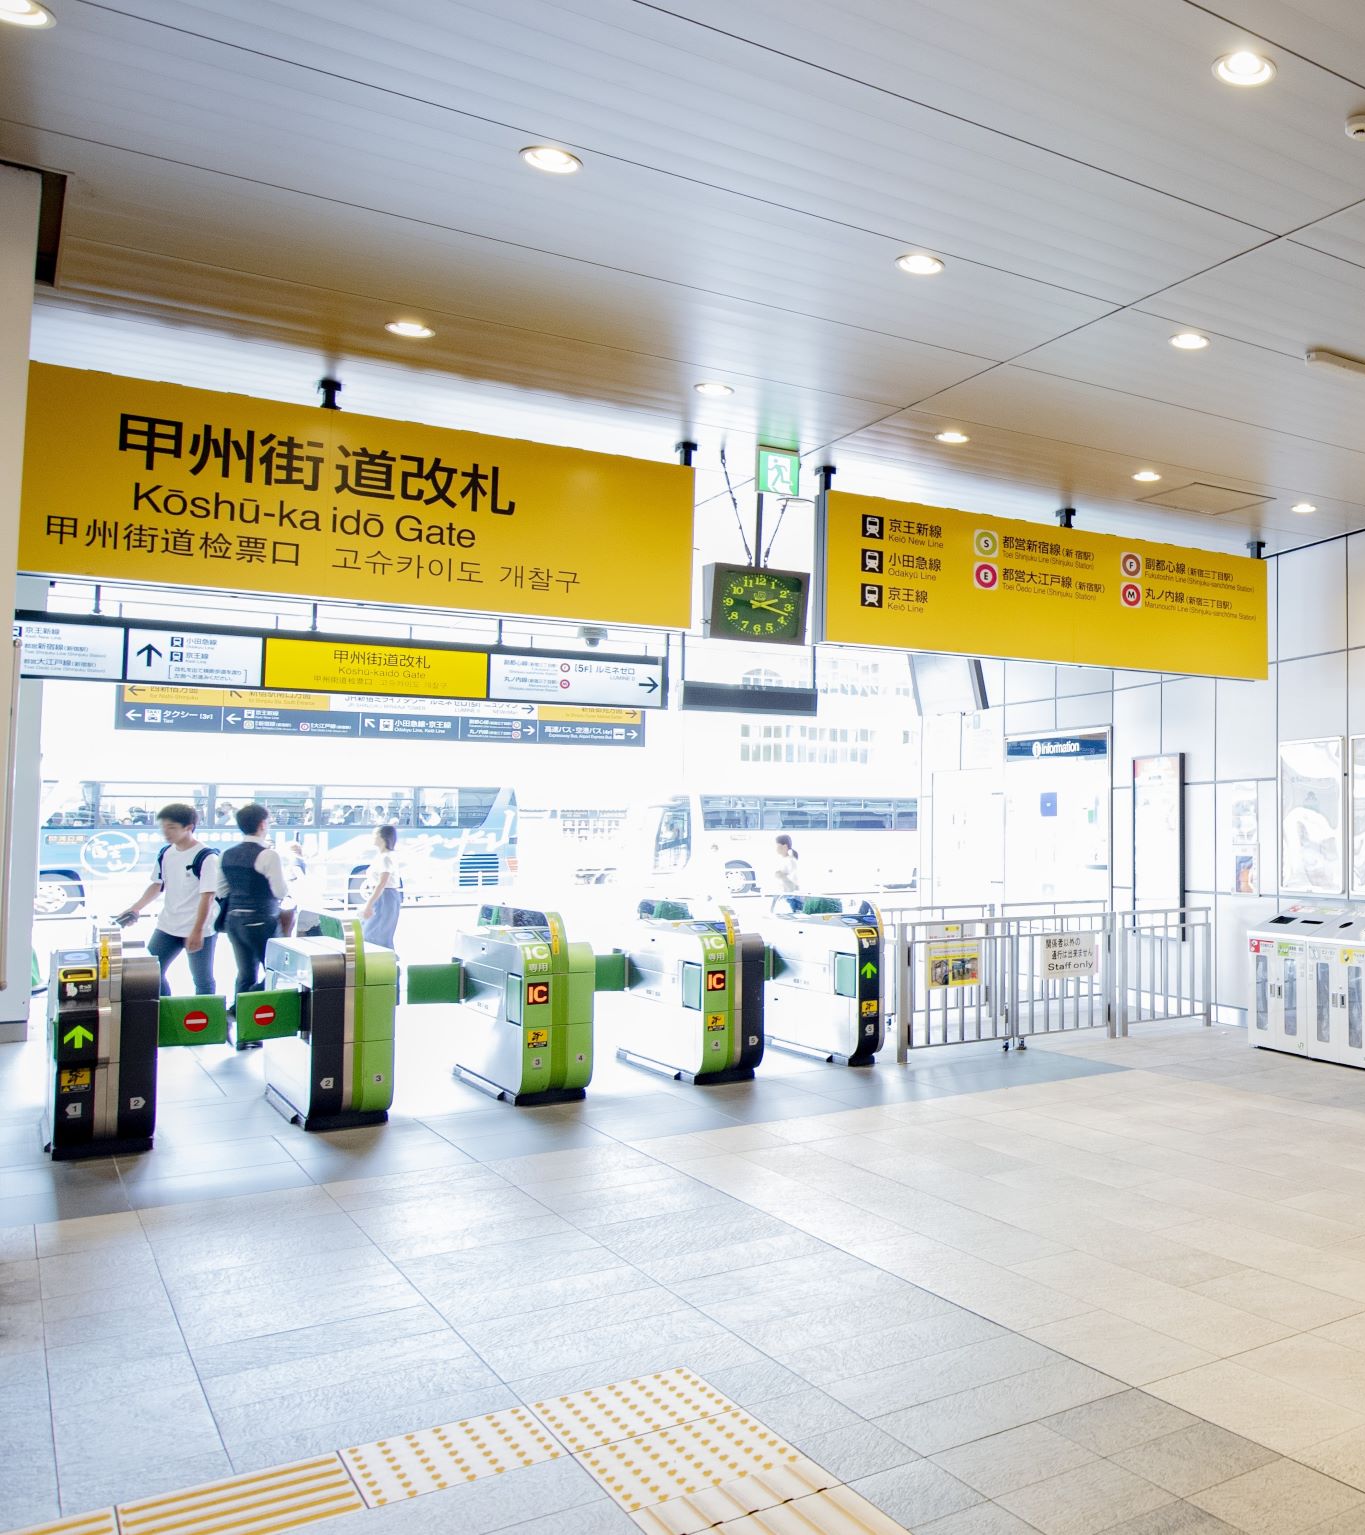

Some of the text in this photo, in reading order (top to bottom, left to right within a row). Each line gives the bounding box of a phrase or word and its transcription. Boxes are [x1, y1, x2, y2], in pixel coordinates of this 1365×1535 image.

[118, 412, 516, 516] 甲州街道改札
[133, 482, 477, 549] Kōshū-kaidō Gate
[889, 519, 942, 538] 京王新線
[46, 514, 301, 567] 甲州街道检票口
[909, 537, 925, 546] New
[928, 539, 943, 548] Line
[984, 540, 989, 548] S
[888, 553, 941, 572] 小田急線
[332, 545, 580, 593] 고슈카이도 개찰구
[921, 572, 936, 581] Line
[984, 572, 989, 580] E
[743, 579, 753, 588] 11
[755, 577, 766, 585] 12
[770, 581, 776, 590] 1
[732, 586, 744, 595] 10
[780, 590, 787, 599] 2
[888, 587, 928, 603] 京王線
[725, 597, 734, 606] 9
[784, 603, 791, 612] 3
[908, 604, 924, 613] Line
[730, 611, 738, 620] 8
[777, 616, 785, 624] 4
[741, 620, 749, 629] 7
[753, 623, 761, 632] 6
[765, 622, 773, 631] 5
[333, 650, 431, 669] 甲州街道改札
[403, 670, 426, 680] Gate
[163, 710, 198, 718] タクシー
[1041, 741, 1079, 755] Information
[703, 936, 725, 950] IC
[524, 945, 548, 960] IC
[528, 963, 548, 972] 専用
[1047, 960, 1093, 971] Staff only
[708, 973, 725, 990] IC
[528, 985, 548, 1004] IC
